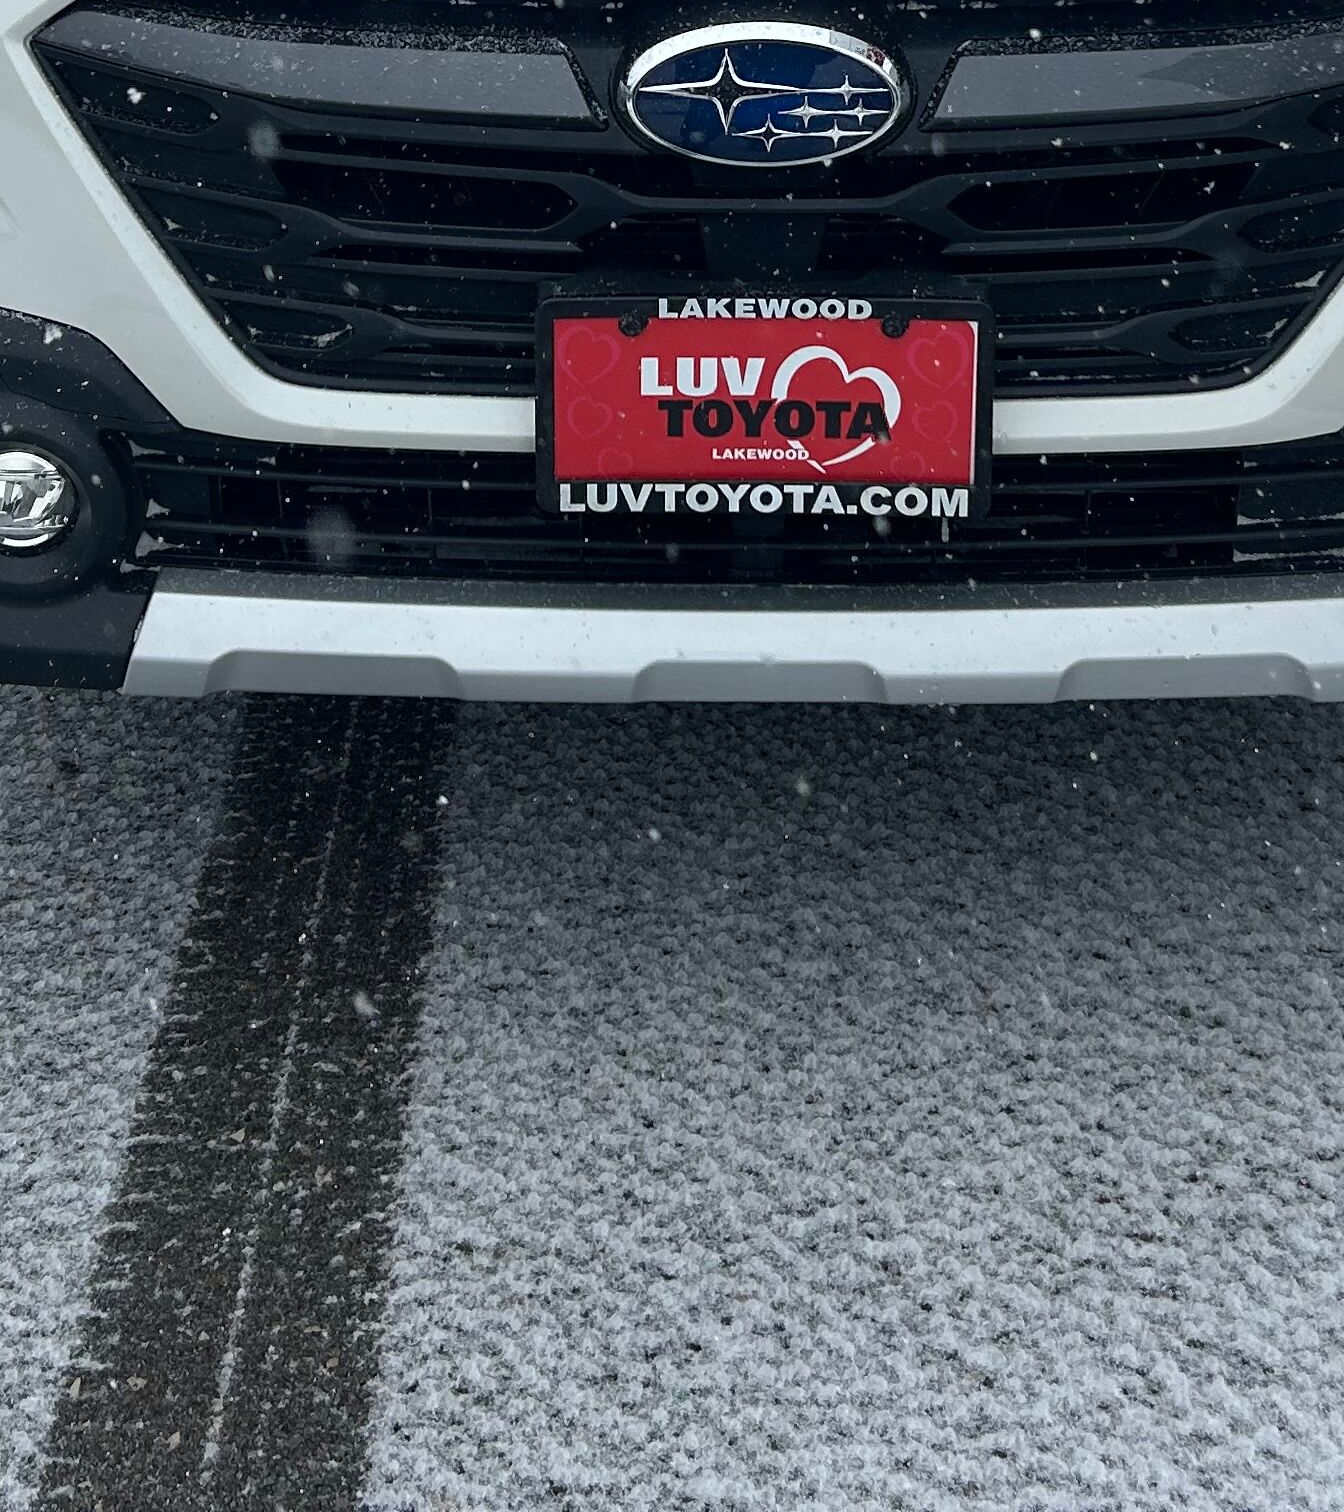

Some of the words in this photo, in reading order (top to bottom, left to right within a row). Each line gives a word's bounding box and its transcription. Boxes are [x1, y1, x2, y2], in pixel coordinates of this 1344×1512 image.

[657, 297, 873, 320] LAKEWOOD
[640, 356, 766, 397] LUV
[658, 399, 892, 441] TOYOTA
[711, 447, 810, 461] LAKEWOOD
[559, 483, 969, 518] LUVTOYOTA.COM
